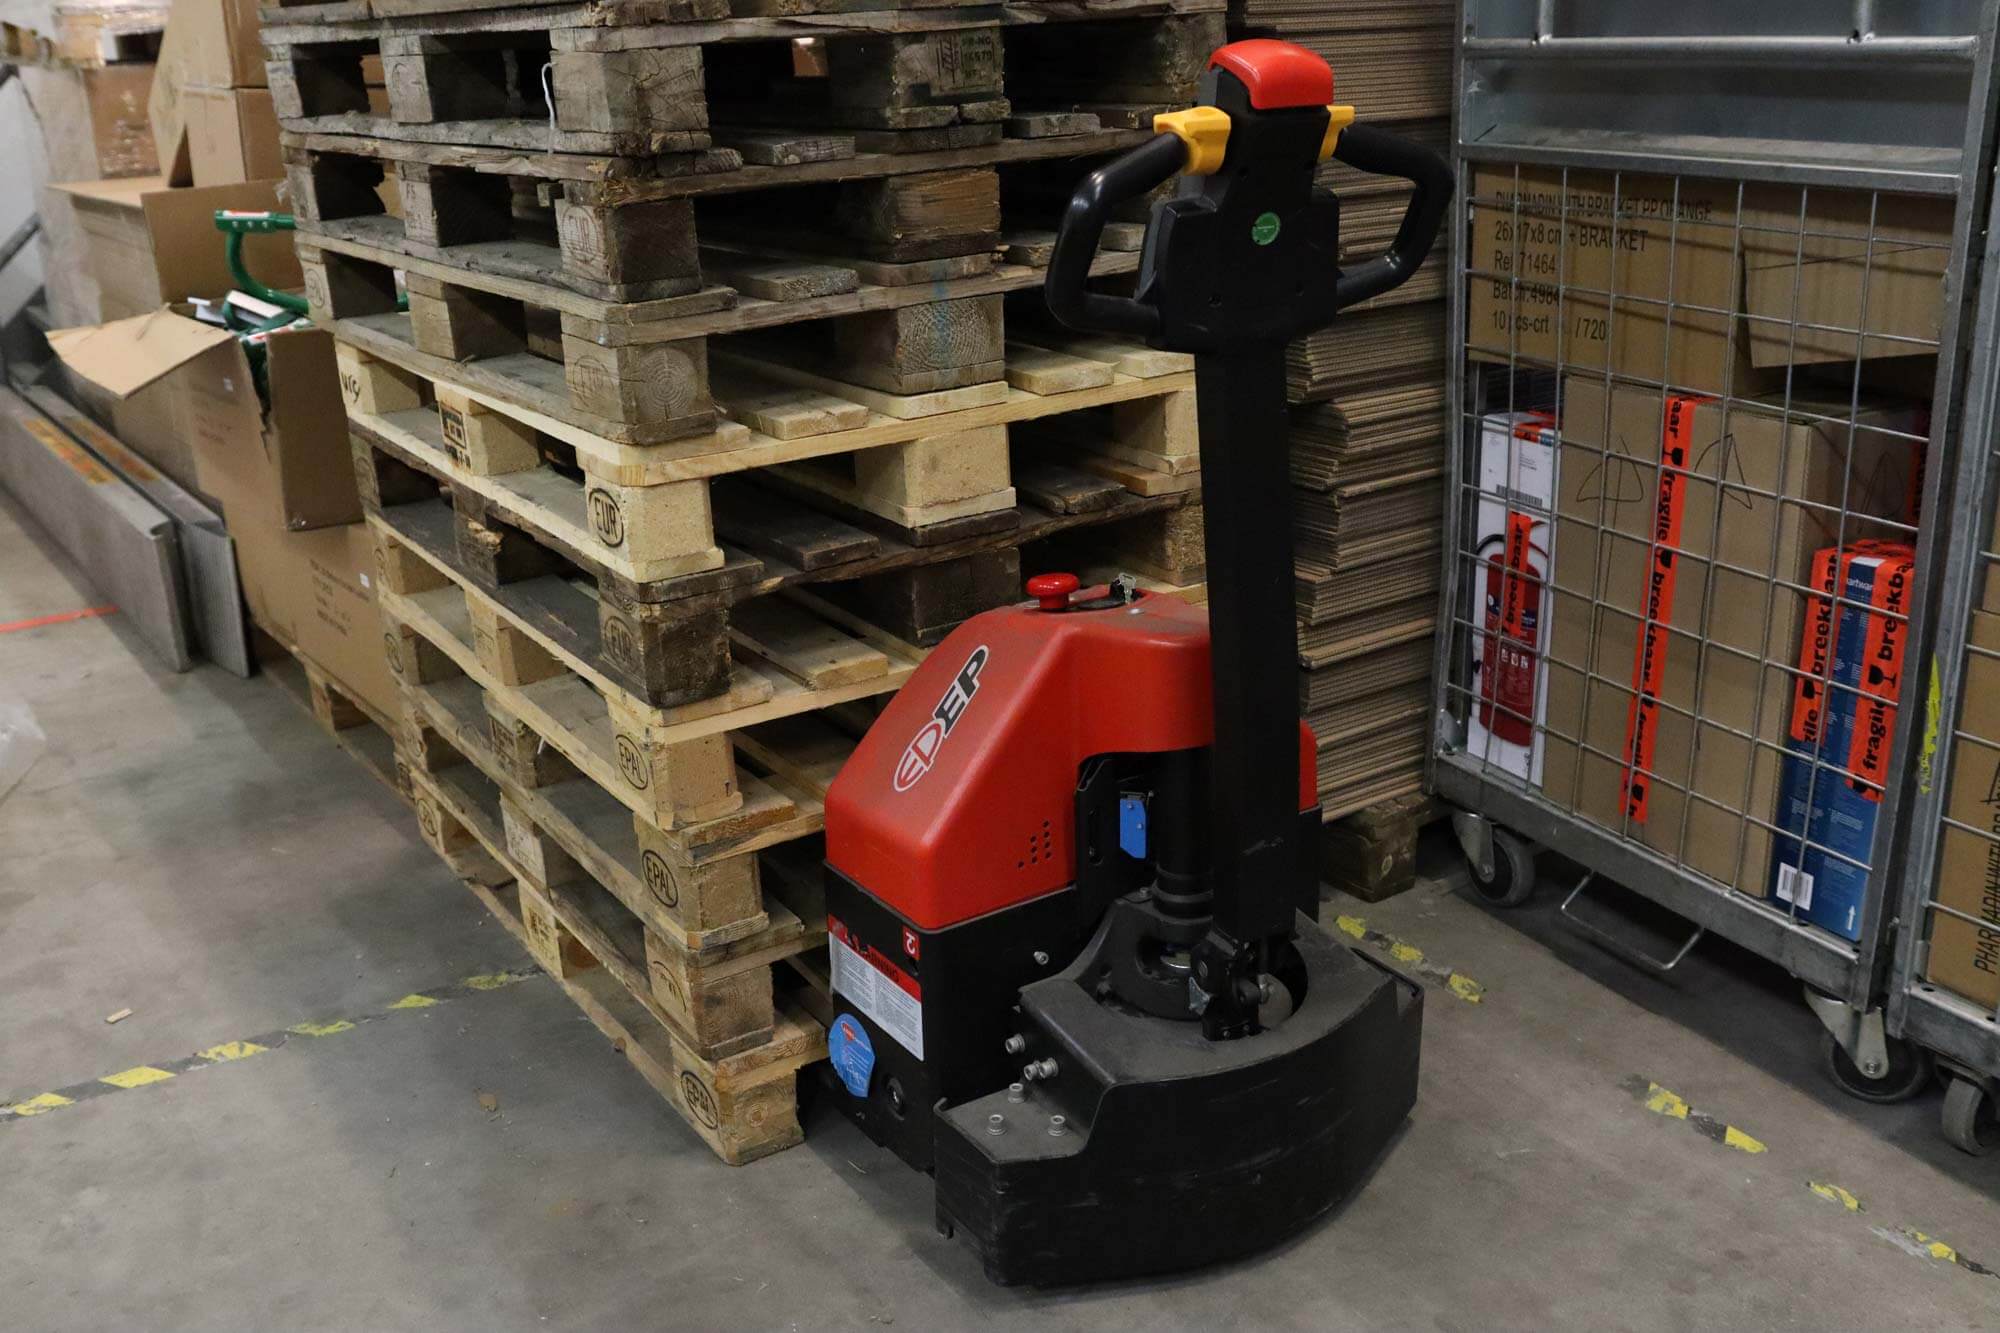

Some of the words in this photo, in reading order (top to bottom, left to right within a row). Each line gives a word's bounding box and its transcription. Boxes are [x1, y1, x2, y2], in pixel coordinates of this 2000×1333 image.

[1587, 195, 1640, 220] BRAKET
[594, 496, 618, 540] EUR
[618, 742, 646, 785] EPAL
[646, 855, 675, 902] EPAL
